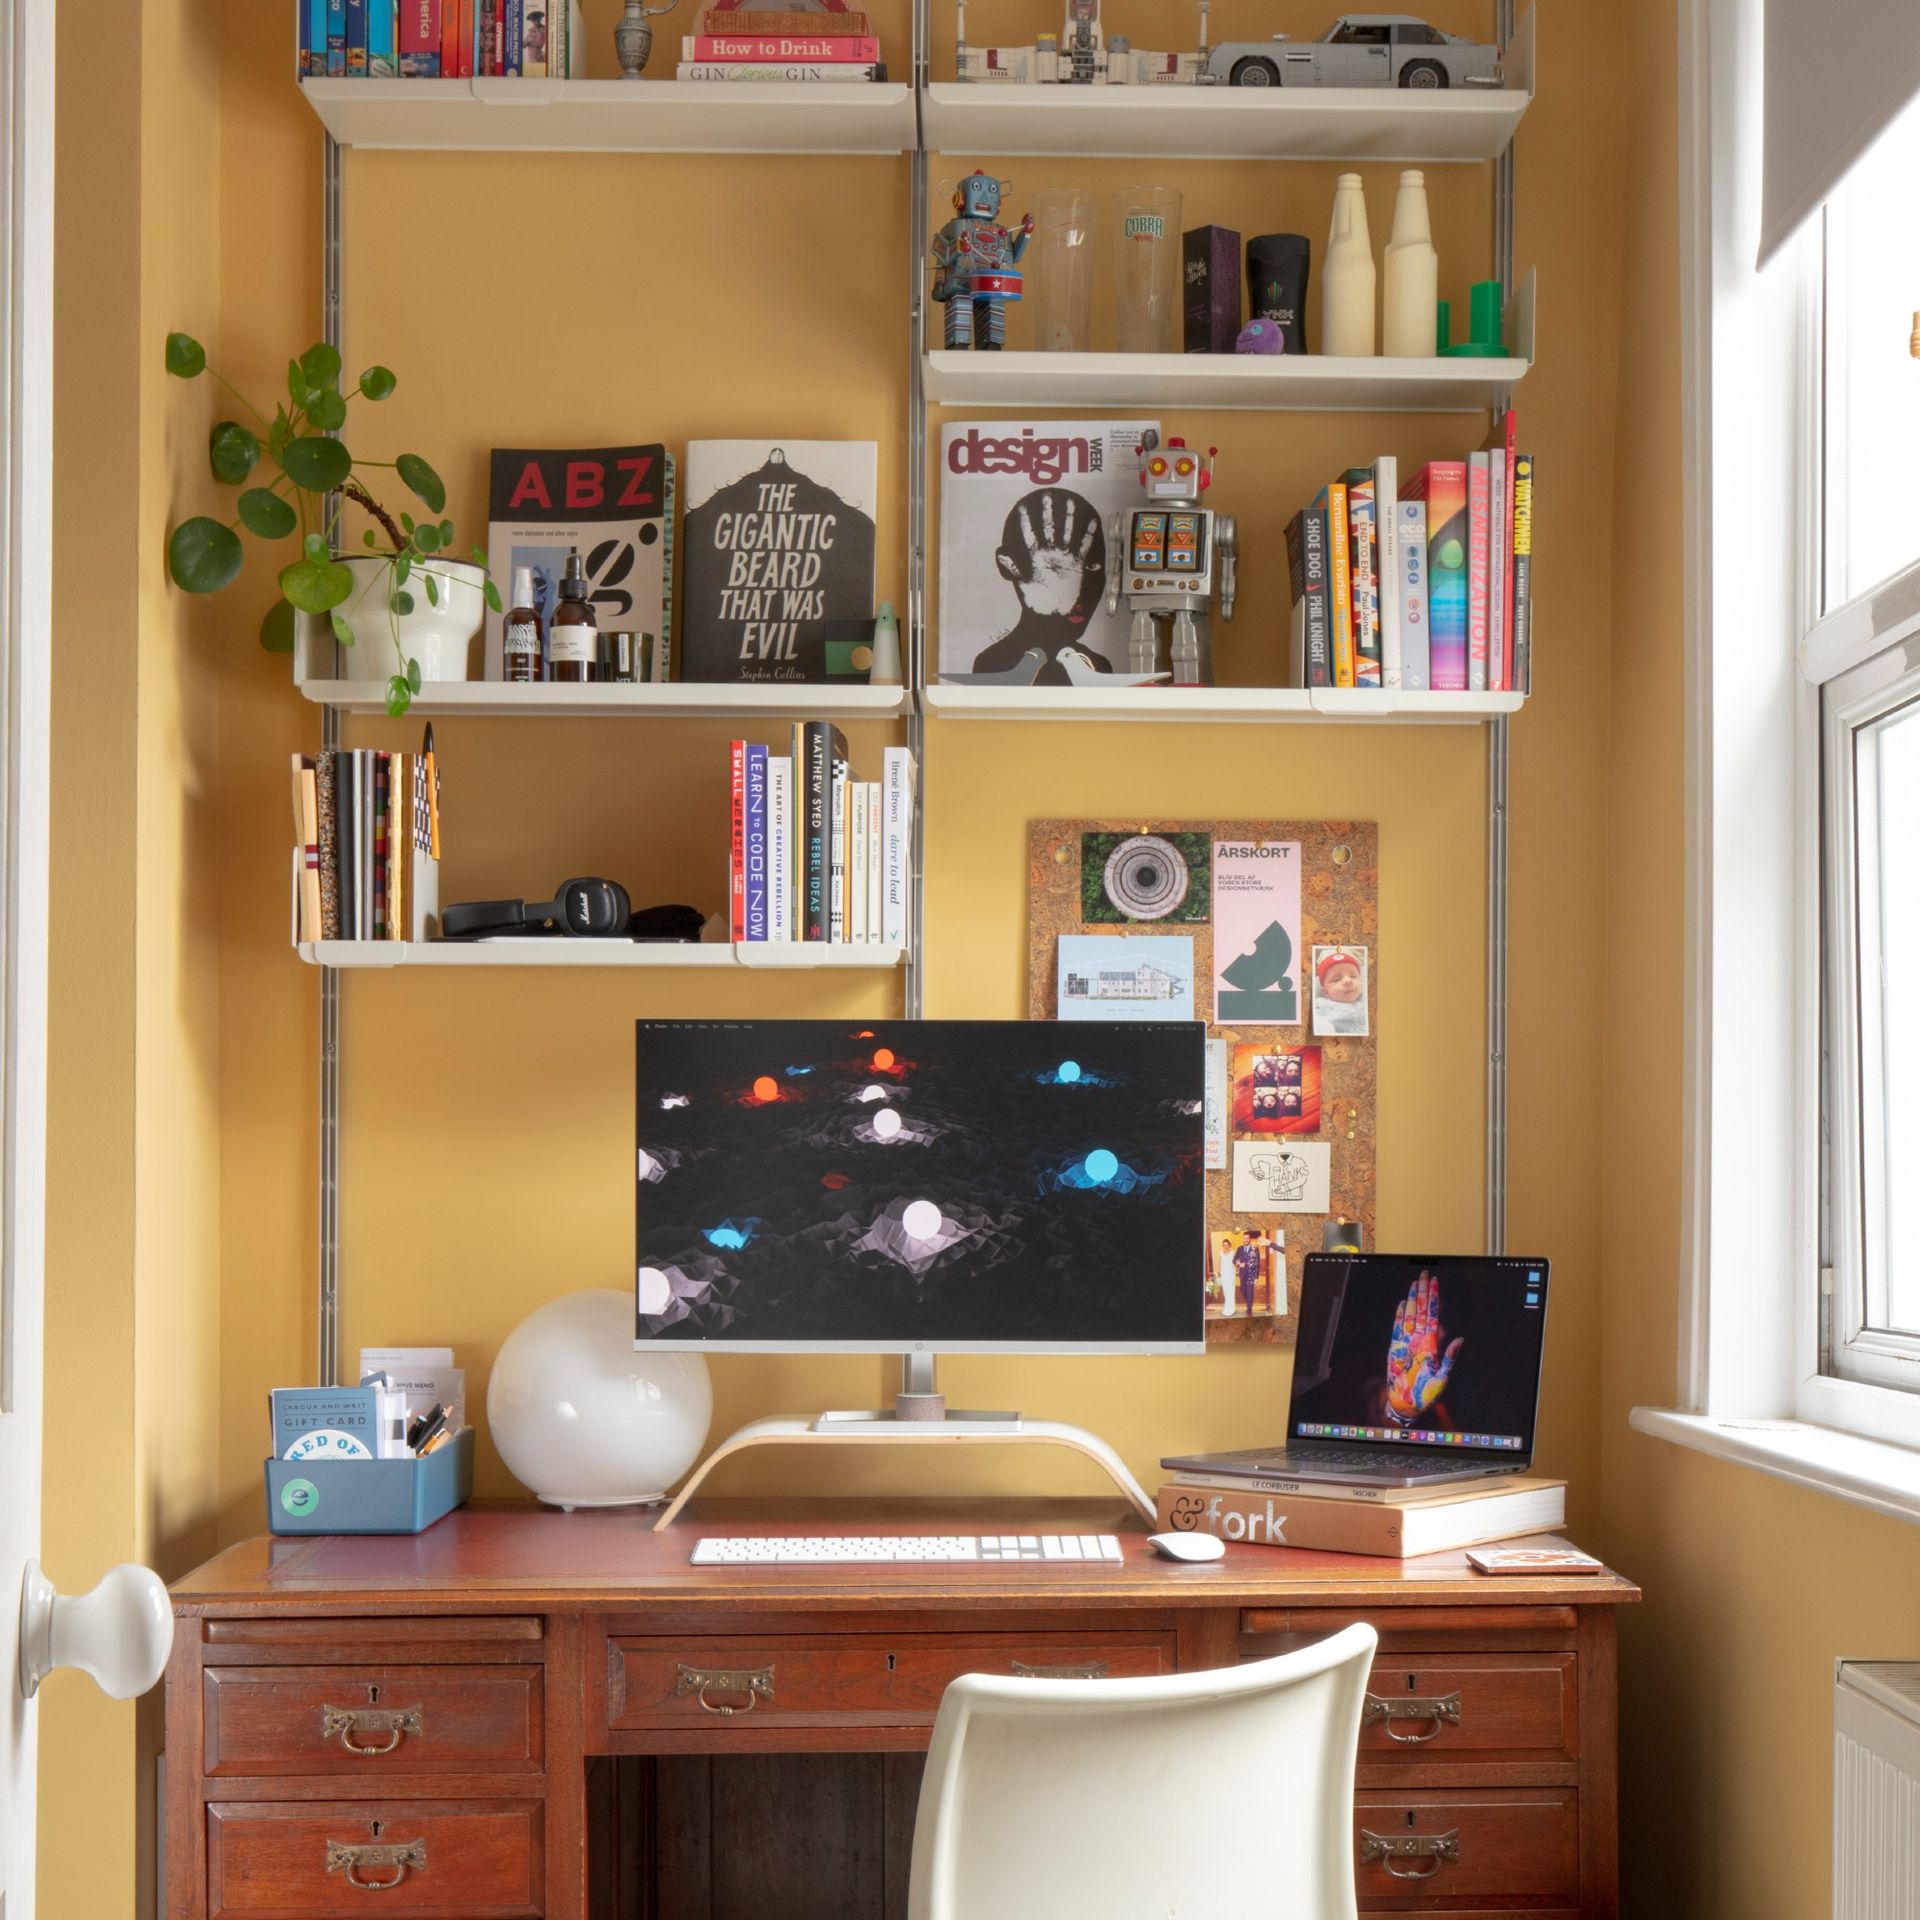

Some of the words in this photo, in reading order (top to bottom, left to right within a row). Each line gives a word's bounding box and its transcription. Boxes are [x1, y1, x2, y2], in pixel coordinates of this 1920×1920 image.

[712, 40, 752, 56] How
[759, 41, 776, 56] to
[780, 40, 833, 56] Drink
[690, 67, 726, 81] GIN
[727, 64, 784, 81] Glorious
[786, 67, 822, 81] GIN
[1125, 216, 1163, 239] COBRA
[948, 429, 1090, 486] design
[1089, 437, 1104, 473] WEEK
[508, 456, 654, 509] ABZ
[757, 483, 798, 512] THE
[714, 512, 837, 551] GIGANTIC
[1333, 492, 1344, 556] Bernardine
[1359, 521, 1369, 542] END
[1514, 478, 1532, 555] WATCHMEN
[1307, 518, 1321, 551] SHOE
[1309, 552, 1322, 578] DOG
[1360, 543, 1369, 558] TO
[1471, 465, 1489, 662] MESMERIZATION
[727, 551, 822, 590] BEARD
[1336, 559, 1346, 605] Evaristo
[1360, 559, 1370, 582] END
[717, 589, 777, 620] THAT
[782, 589, 825, 621] WAS
[1310, 595, 1323, 620] PHIL
[1361, 591, 1370, 610] Paul
[1362, 611, 1370, 636] Jones
[738, 622, 799, 661] EVIL
[1311, 622, 1325, 664] KNIGHT
[738, 665, 772, 683] Stephen
[774, 666, 807, 680] Collins
[733, 749, 743, 797] SMALL
[811, 734, 823, 794] MATTHEW
[891, 760, 901, 789] Brené
[750, 754, 763, 813] LEARN
[811, 798, 823, 829] SYED
[835, 784, 843, 816] Mismatch
[891, 791, 900, 823] Brown
[753, 818, 760, 828] TO
[775, 814, 782, 827] OF
[750, 832, 763, 882] CODE
[810, 837, 822, 873] REBEL
[890, 834, 900, 863] dare
[1217, 844, 1291, 858] ÅRSKORT
[890, 864, 899, 877] to
[810, 876, 821, 913] IDEAS
[890, 879, 900, 905] lead
[750, 889, 763, 937] NOW
[282, 1402, 318, 1411] LABOUR
[344, 1402, 367, 1410] WAIT
[284, 1417, 318, 1427] GIFT
[326, 1416, 367, 1426] CARD
[1252, 1480, 1260, 1489] LE
[1261, 1481, 1300, 1492] CORBUSIER
[1352, 1489, 1377, 1498] TASCHEN
[1206, 1495, 1288, 1544] fork
